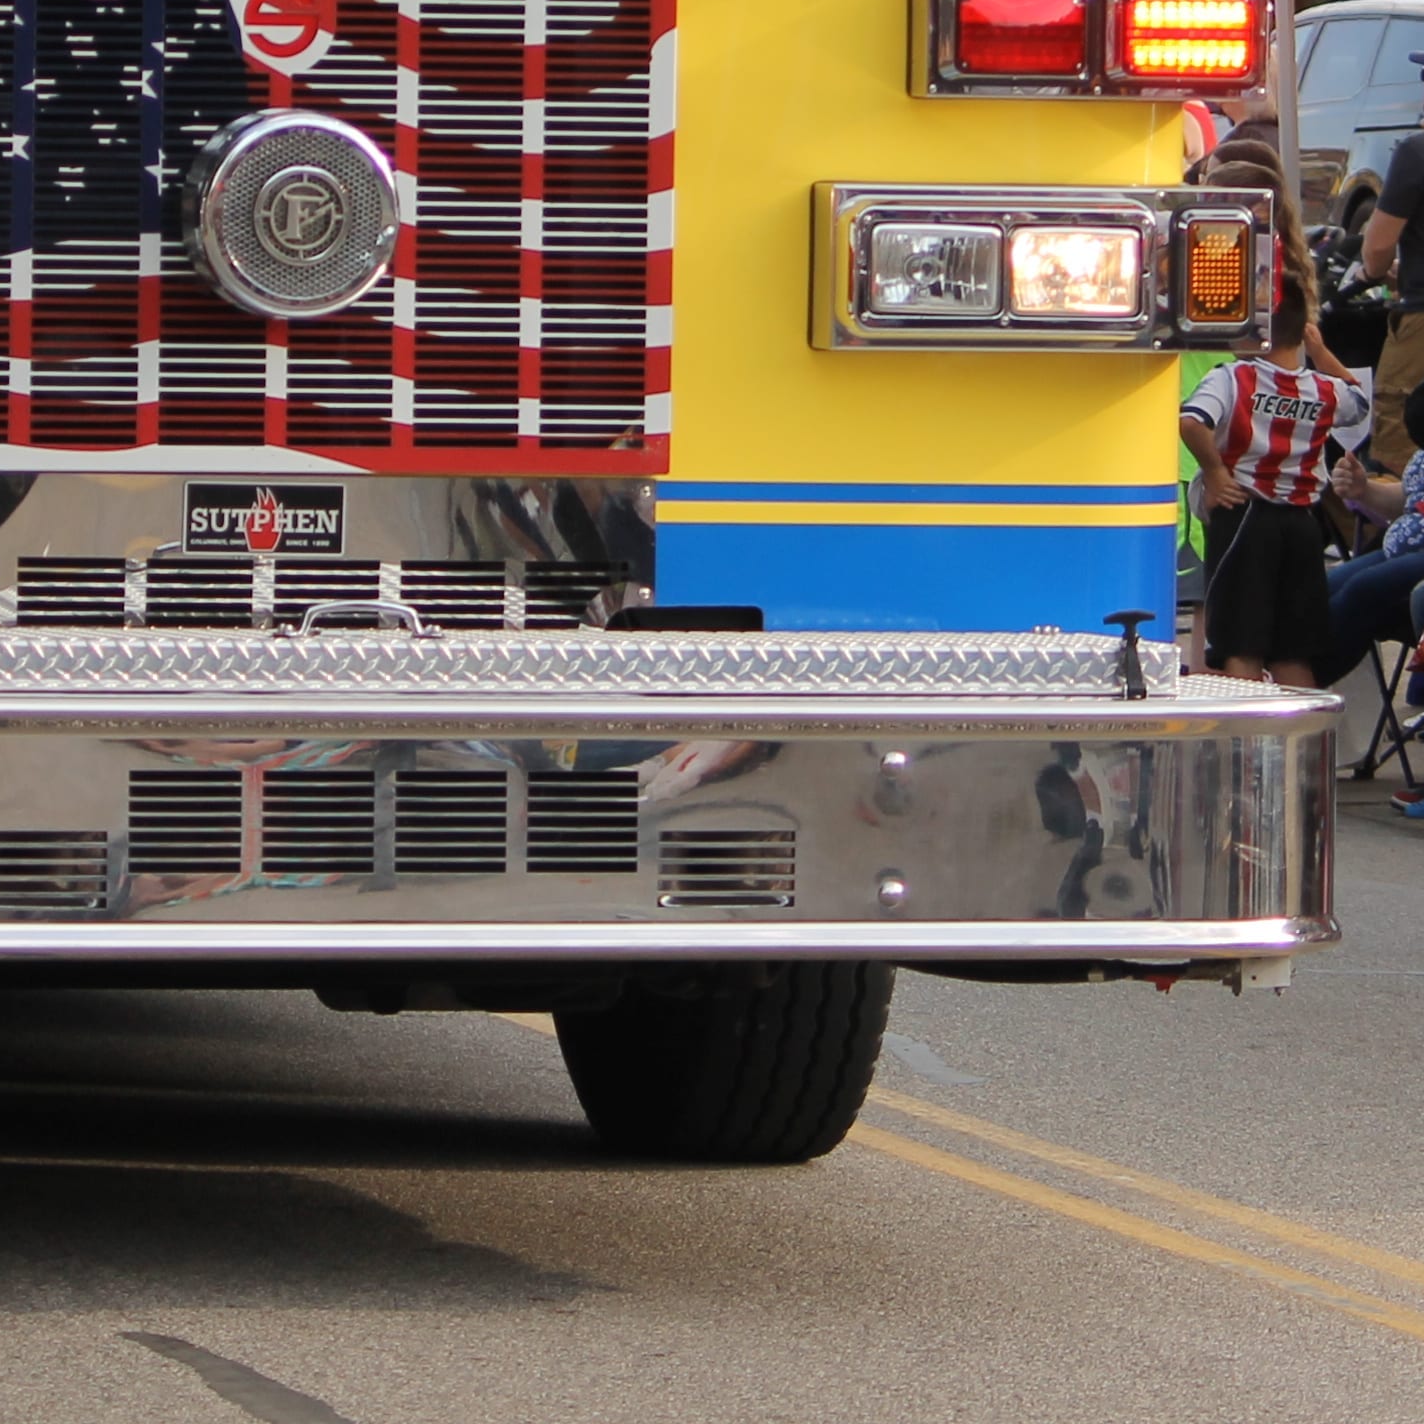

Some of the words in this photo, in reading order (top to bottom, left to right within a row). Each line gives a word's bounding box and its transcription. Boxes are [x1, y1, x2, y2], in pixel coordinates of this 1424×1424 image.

[1253, 392, 1324, 422] TECATE
[190, 507, 339, 534] SUTPHEN
[286, 539, 308, 547] SINCE
